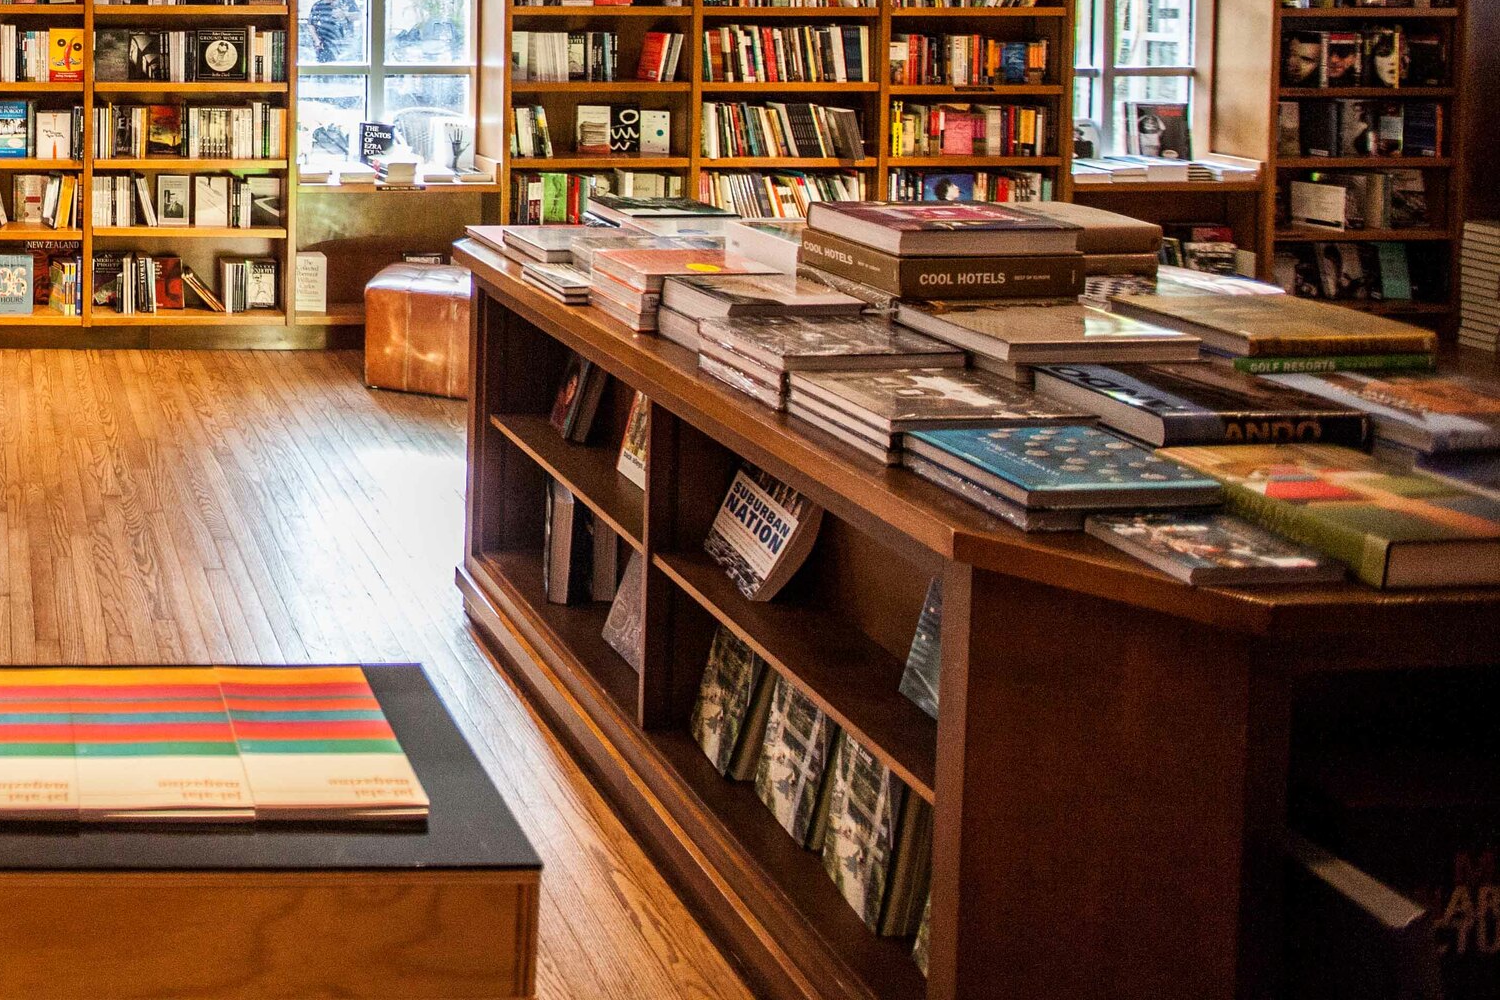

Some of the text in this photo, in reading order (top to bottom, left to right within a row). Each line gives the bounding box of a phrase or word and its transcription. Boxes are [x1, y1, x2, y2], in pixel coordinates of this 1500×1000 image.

[364, 131, 391, 139] CANTOS
[27, 241, 79, 249] NEW ZEALAND
[803, 240, 823, 256] COOL
[824, 247, 854, 266] HOTELS
[919, 273, 953, 285] COOL
[957, 272, 1006, 285] HOTELS
[1250, 360, 1336, 373] GOLF RESORTS
[1224, 419, 1323, 442] ANDO
[733, 480, 791, 539] SUBURBAN
[725, 492, 784, 555] NATION
[158, 780, 240, 791] magazine
[328, 777, 409, 788] magazine
